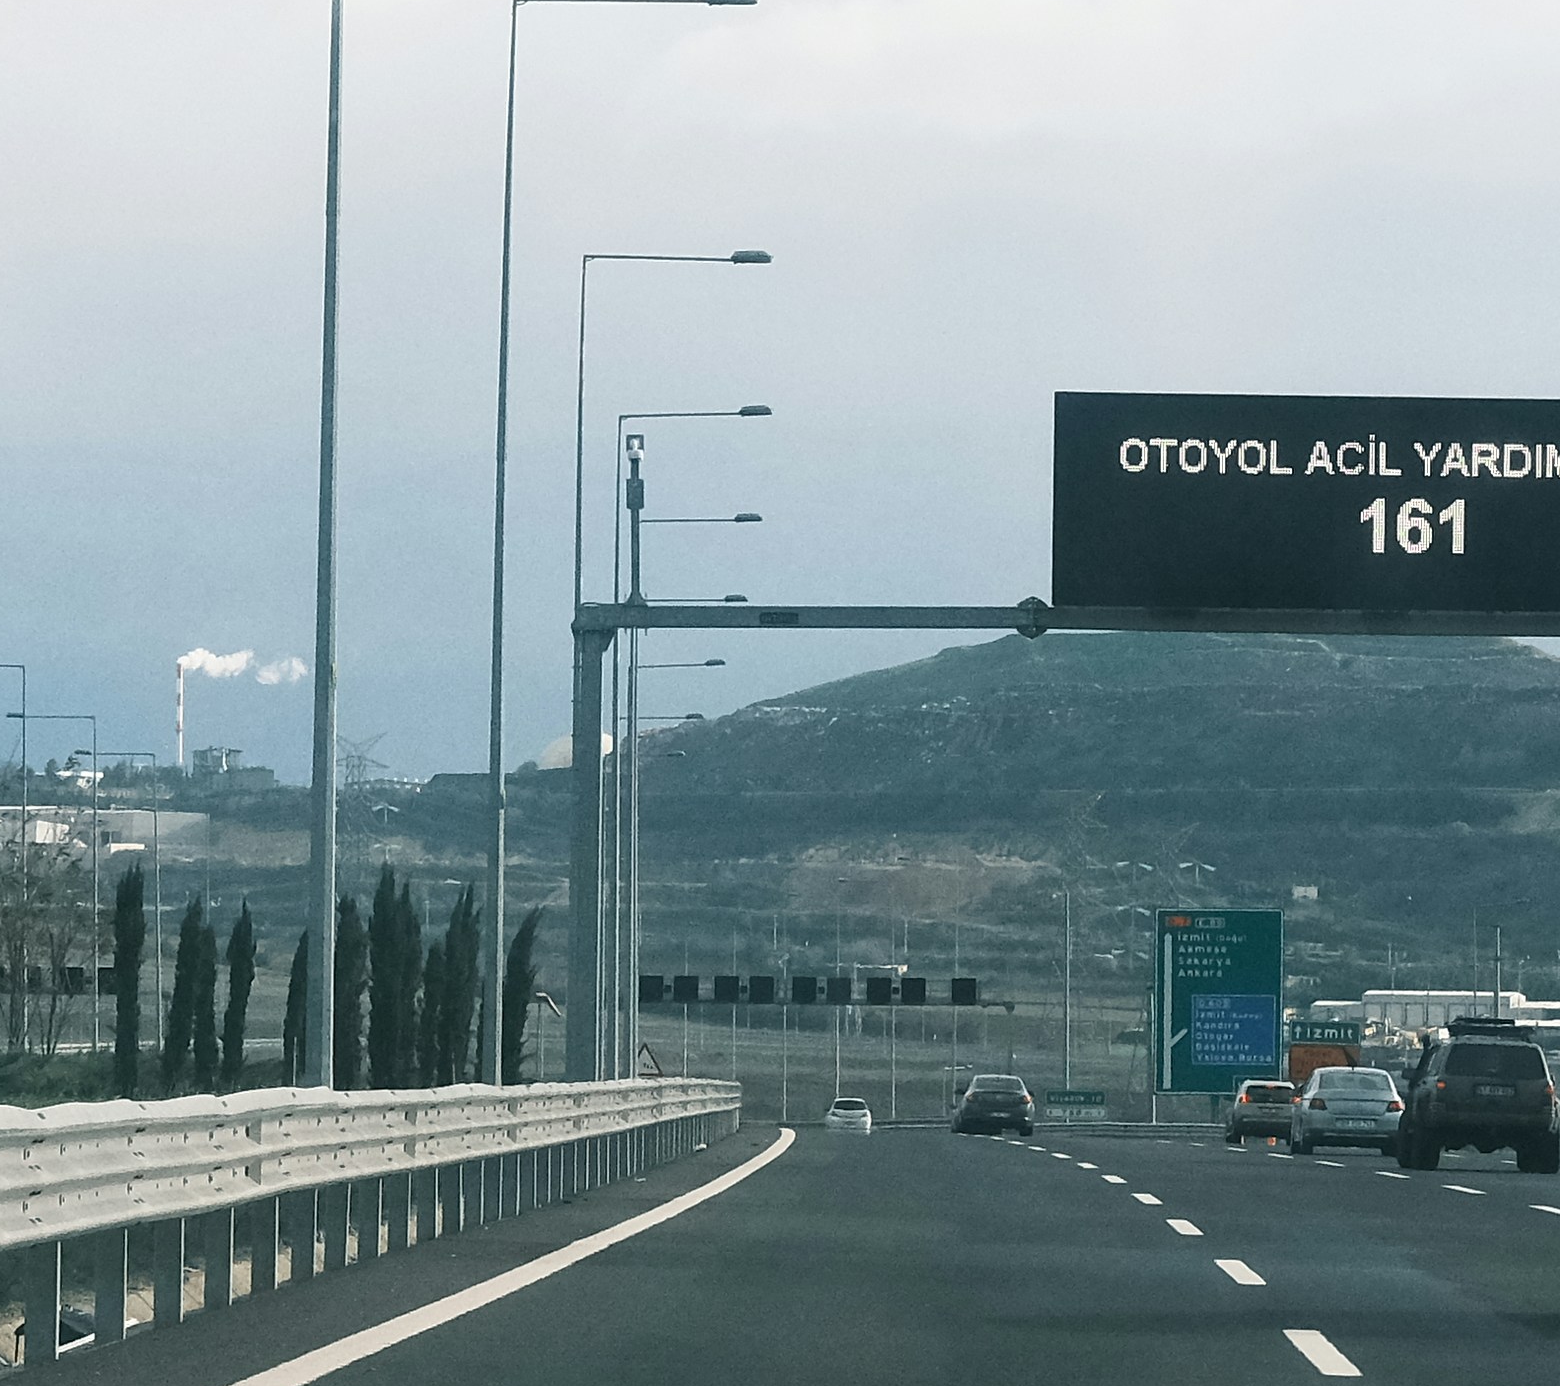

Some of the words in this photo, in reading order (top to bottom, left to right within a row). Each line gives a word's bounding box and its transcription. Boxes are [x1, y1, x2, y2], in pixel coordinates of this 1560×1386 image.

[1119, 437, 1293, 476] OTOYOL
[1305, 434, 1402, 476] ACİL
[1359, 497, 1466, 555] 161
[1177, 968, 1223, 977] Ankara
[1178, 956, 1231, 967] Sakarya
